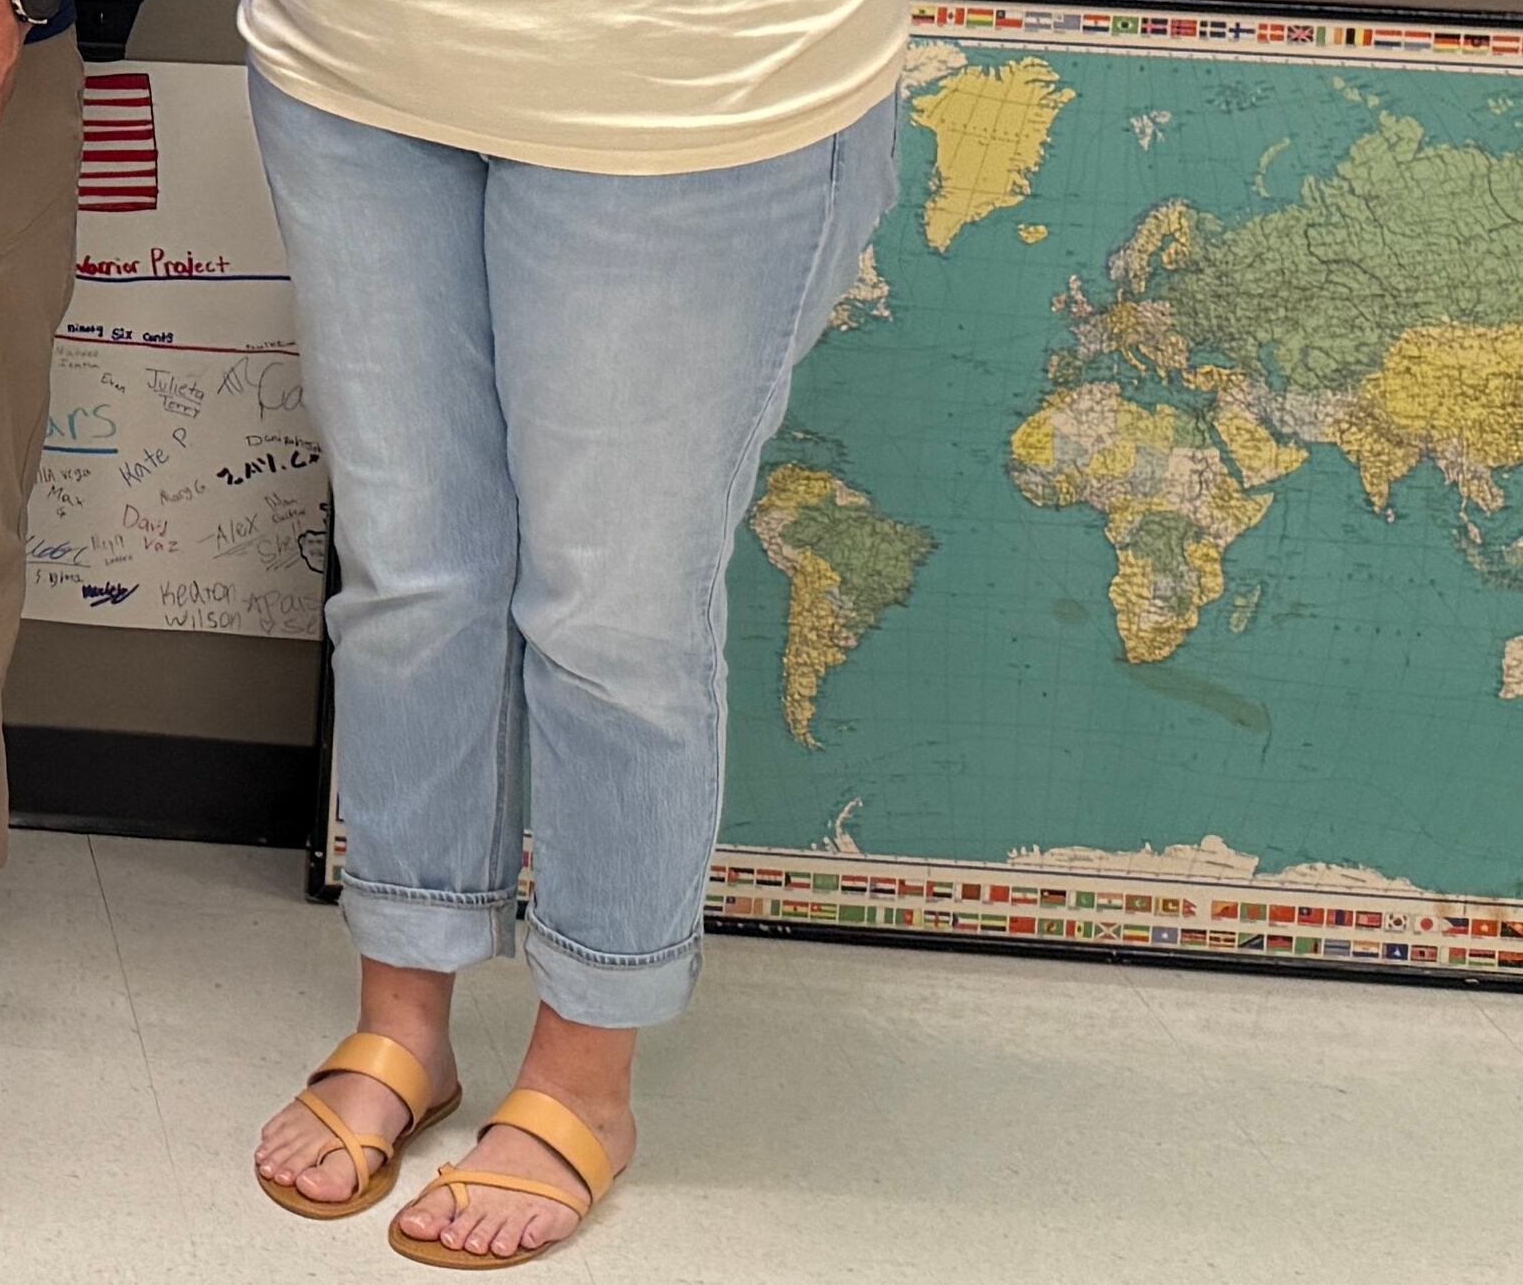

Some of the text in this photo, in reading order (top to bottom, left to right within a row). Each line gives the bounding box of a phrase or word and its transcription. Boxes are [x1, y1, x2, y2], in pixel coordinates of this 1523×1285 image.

[149, 246, 231, 277] Project
[145, 367, 206, 401] Julieta
[118, 447, 171, 489] Kate
[214, 513, 259, 550] Alex
